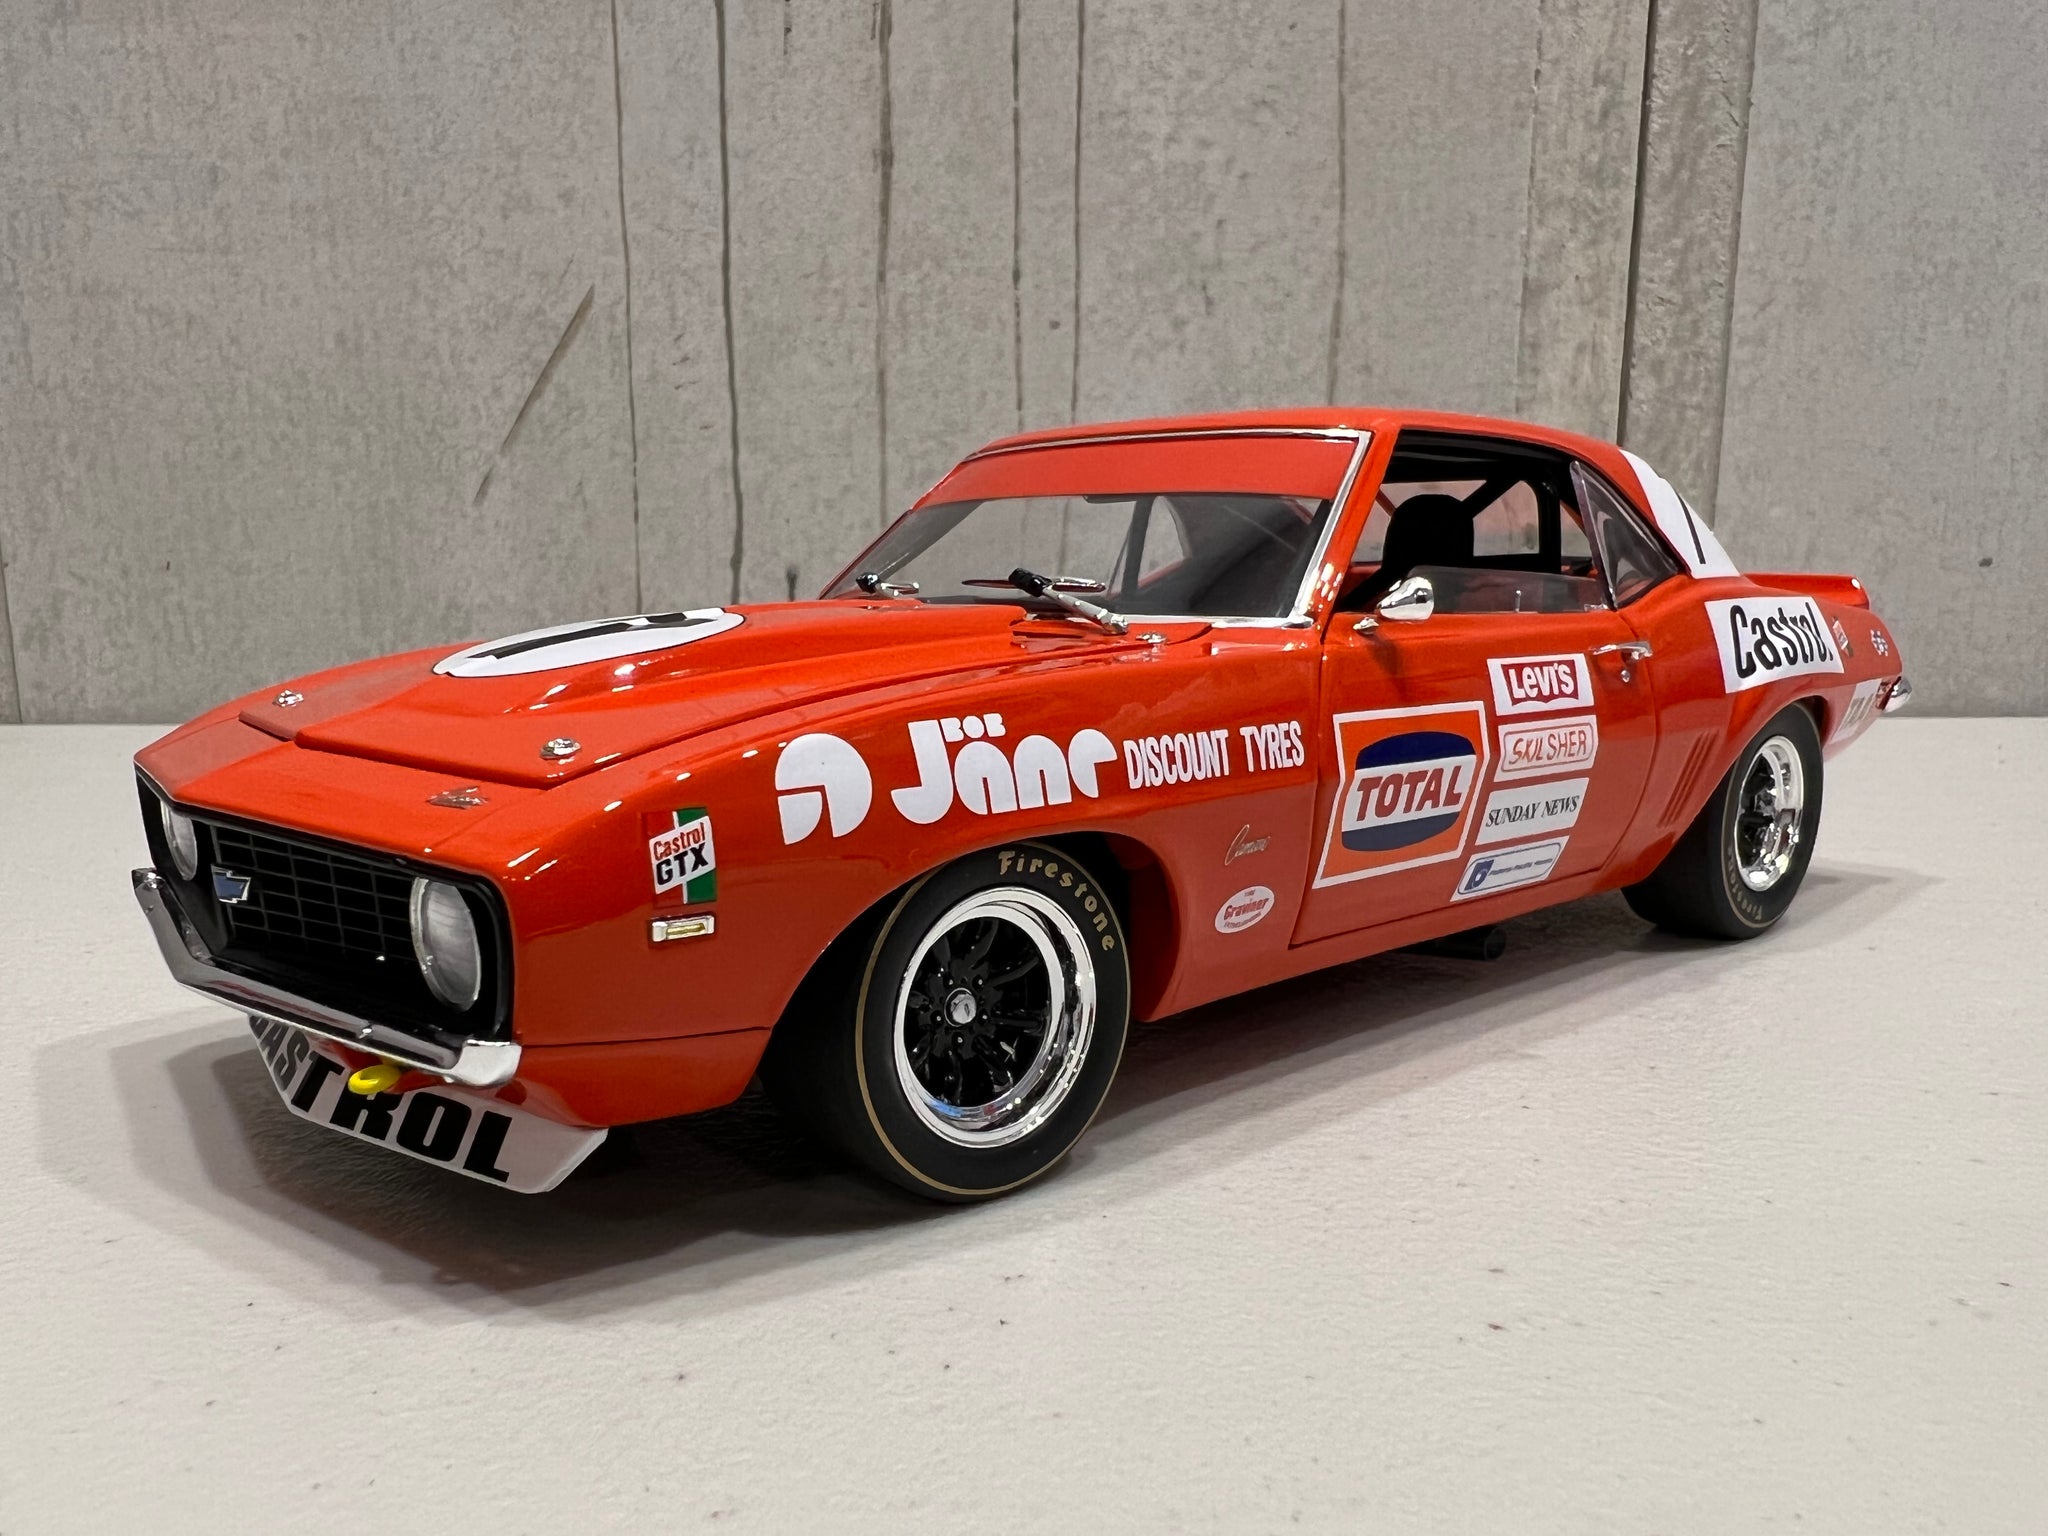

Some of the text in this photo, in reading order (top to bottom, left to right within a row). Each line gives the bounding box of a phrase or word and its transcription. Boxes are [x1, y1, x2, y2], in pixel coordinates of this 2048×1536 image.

[1730, 602, 1833, 679] Castrol
[1508, 662, 1575, 699] Levi's
[940, 712, 1006, 743] BOB
[1508, 729, 1587, 765] SKIL SHER
[891, 719, 1305, 824] Jane DISCOUNT TYRES
[1356, 765, 1462, 822] TOTAL
[1485, 795, 1580, 828] SUNDAY NEWS
[653, 821, 706, 861] Castrol
[655, 842, 709, 885] GTX
[997, 850, 1115, 951] Firestone
